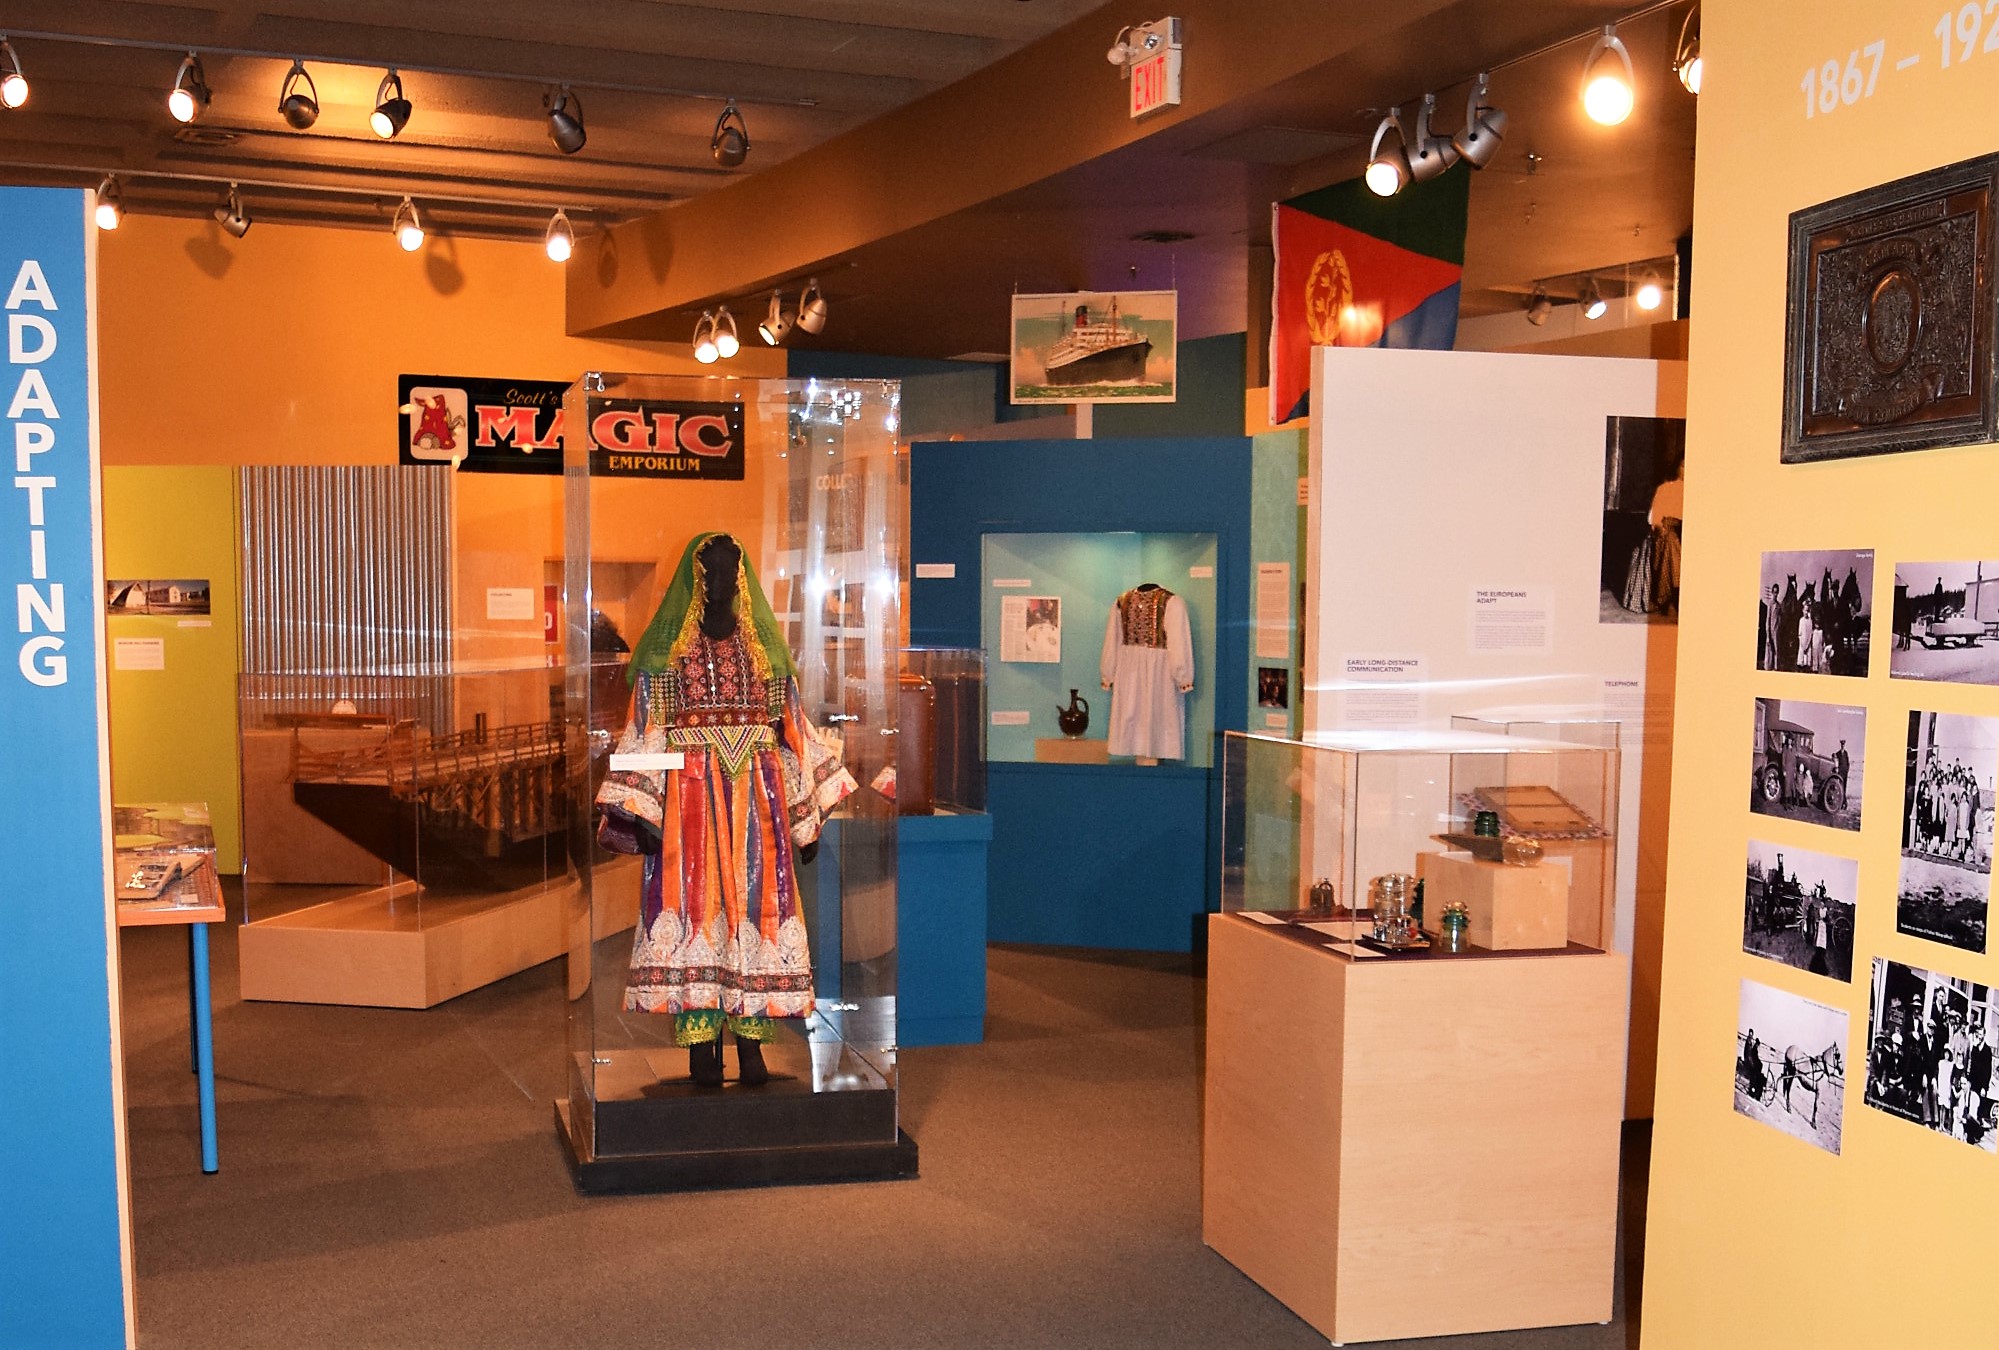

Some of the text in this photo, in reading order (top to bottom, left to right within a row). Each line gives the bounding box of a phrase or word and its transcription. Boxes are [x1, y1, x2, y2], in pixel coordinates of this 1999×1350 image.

[1135, 56, 1164, 111] EXIT
[1801, 39, 1885, 119] 1867
[504, 388, 558, 404] Scott's
[5, 259, 68, 687] ADAPTING
[609, 455, 700, 471] EMPORIUM
